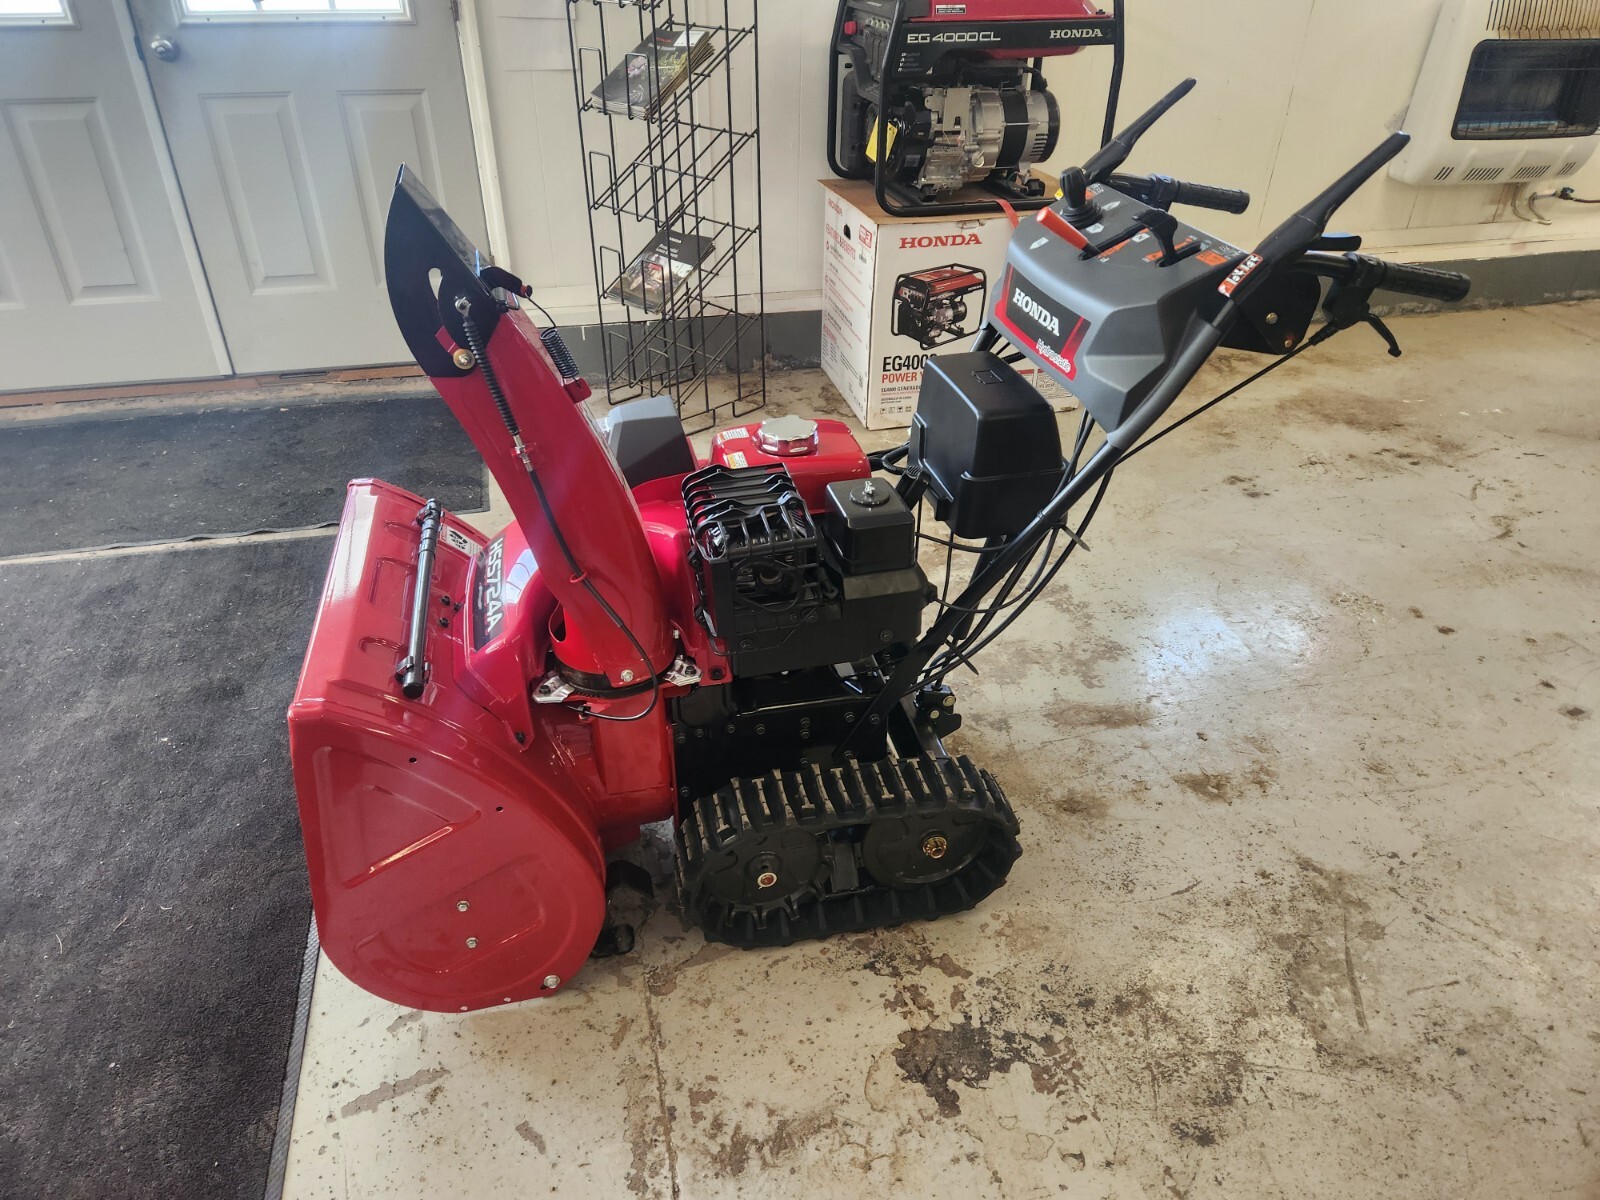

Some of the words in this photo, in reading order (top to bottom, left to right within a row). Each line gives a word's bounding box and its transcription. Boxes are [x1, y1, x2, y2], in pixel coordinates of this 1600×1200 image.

[1049, 28, 1103, 39] HONDA
[898, 233, 982, 249] HONDA
[1012, 287, 1060, 337] HONDA
[882, 353, 937, 373] EG400
[881, 371, 918, 384] POWER
[486, 537, 504, 633] HSS724A
